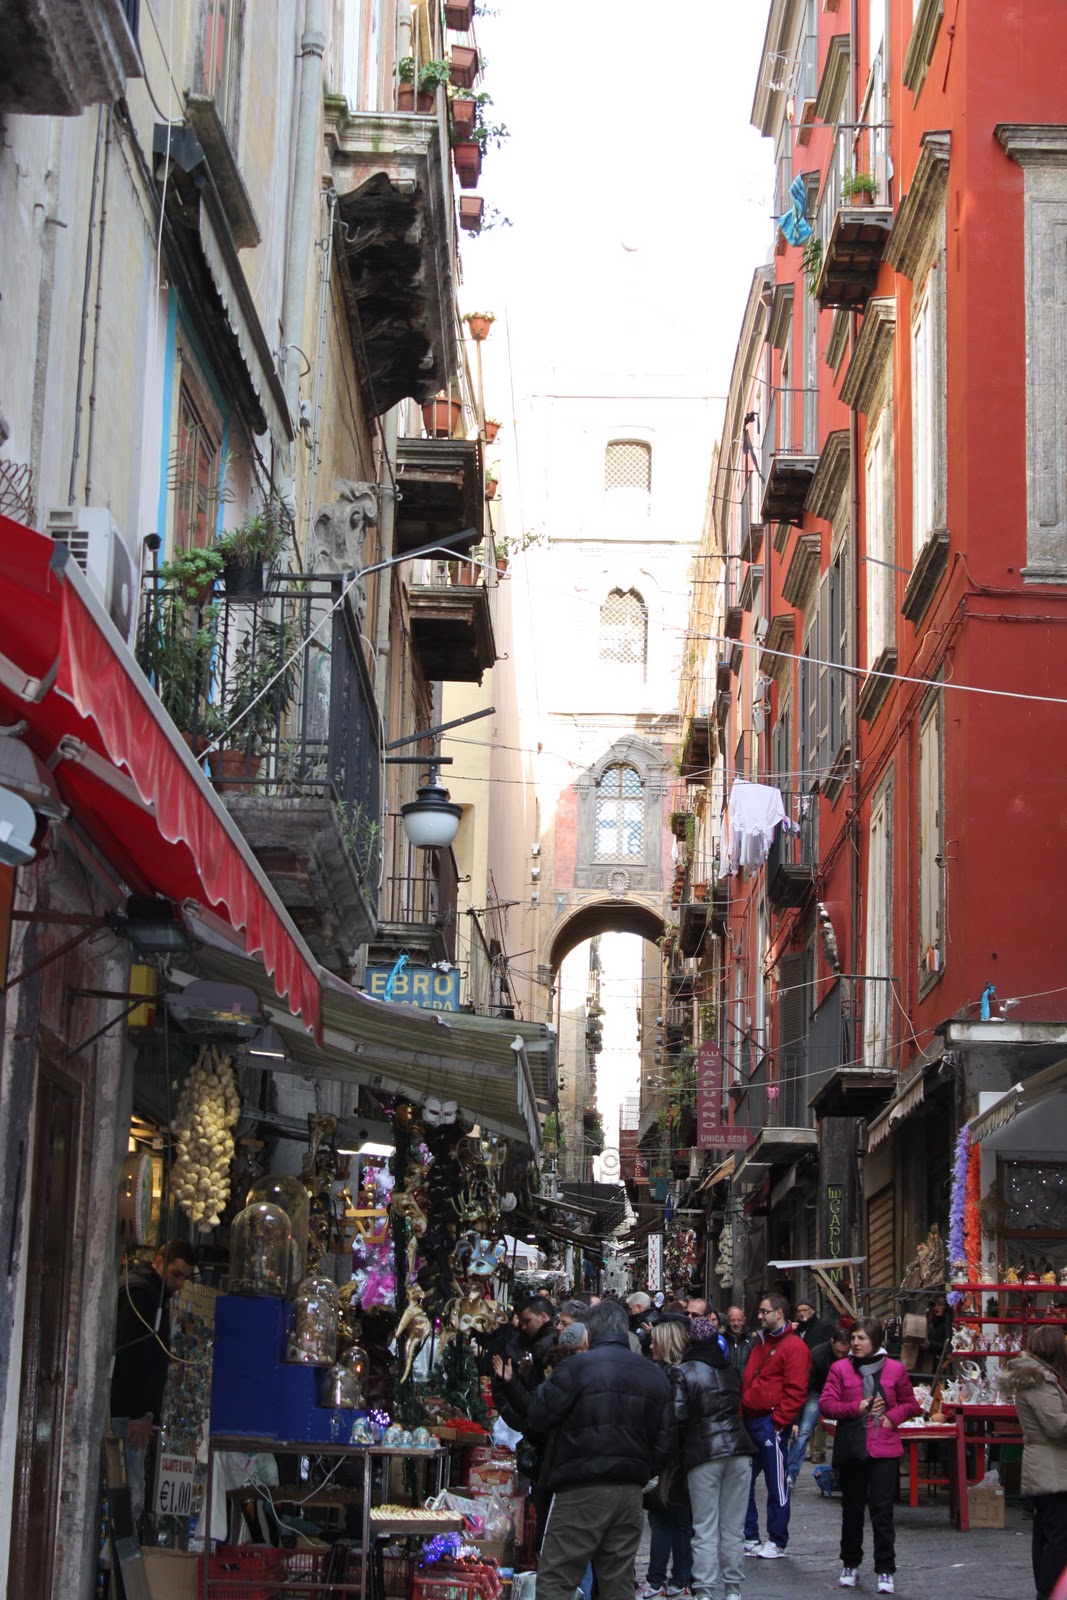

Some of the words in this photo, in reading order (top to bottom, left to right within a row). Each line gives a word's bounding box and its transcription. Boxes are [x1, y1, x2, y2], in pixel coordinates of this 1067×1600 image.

[361, 973, 453, 996] EBRO
[702, 1060, 716, 1129] CAPUANO
[701, 1134, 725, 1143] UNICA
[727, 1135, 748, 1143] SEDE
[160, 1480, 191, 1514] €1.00
